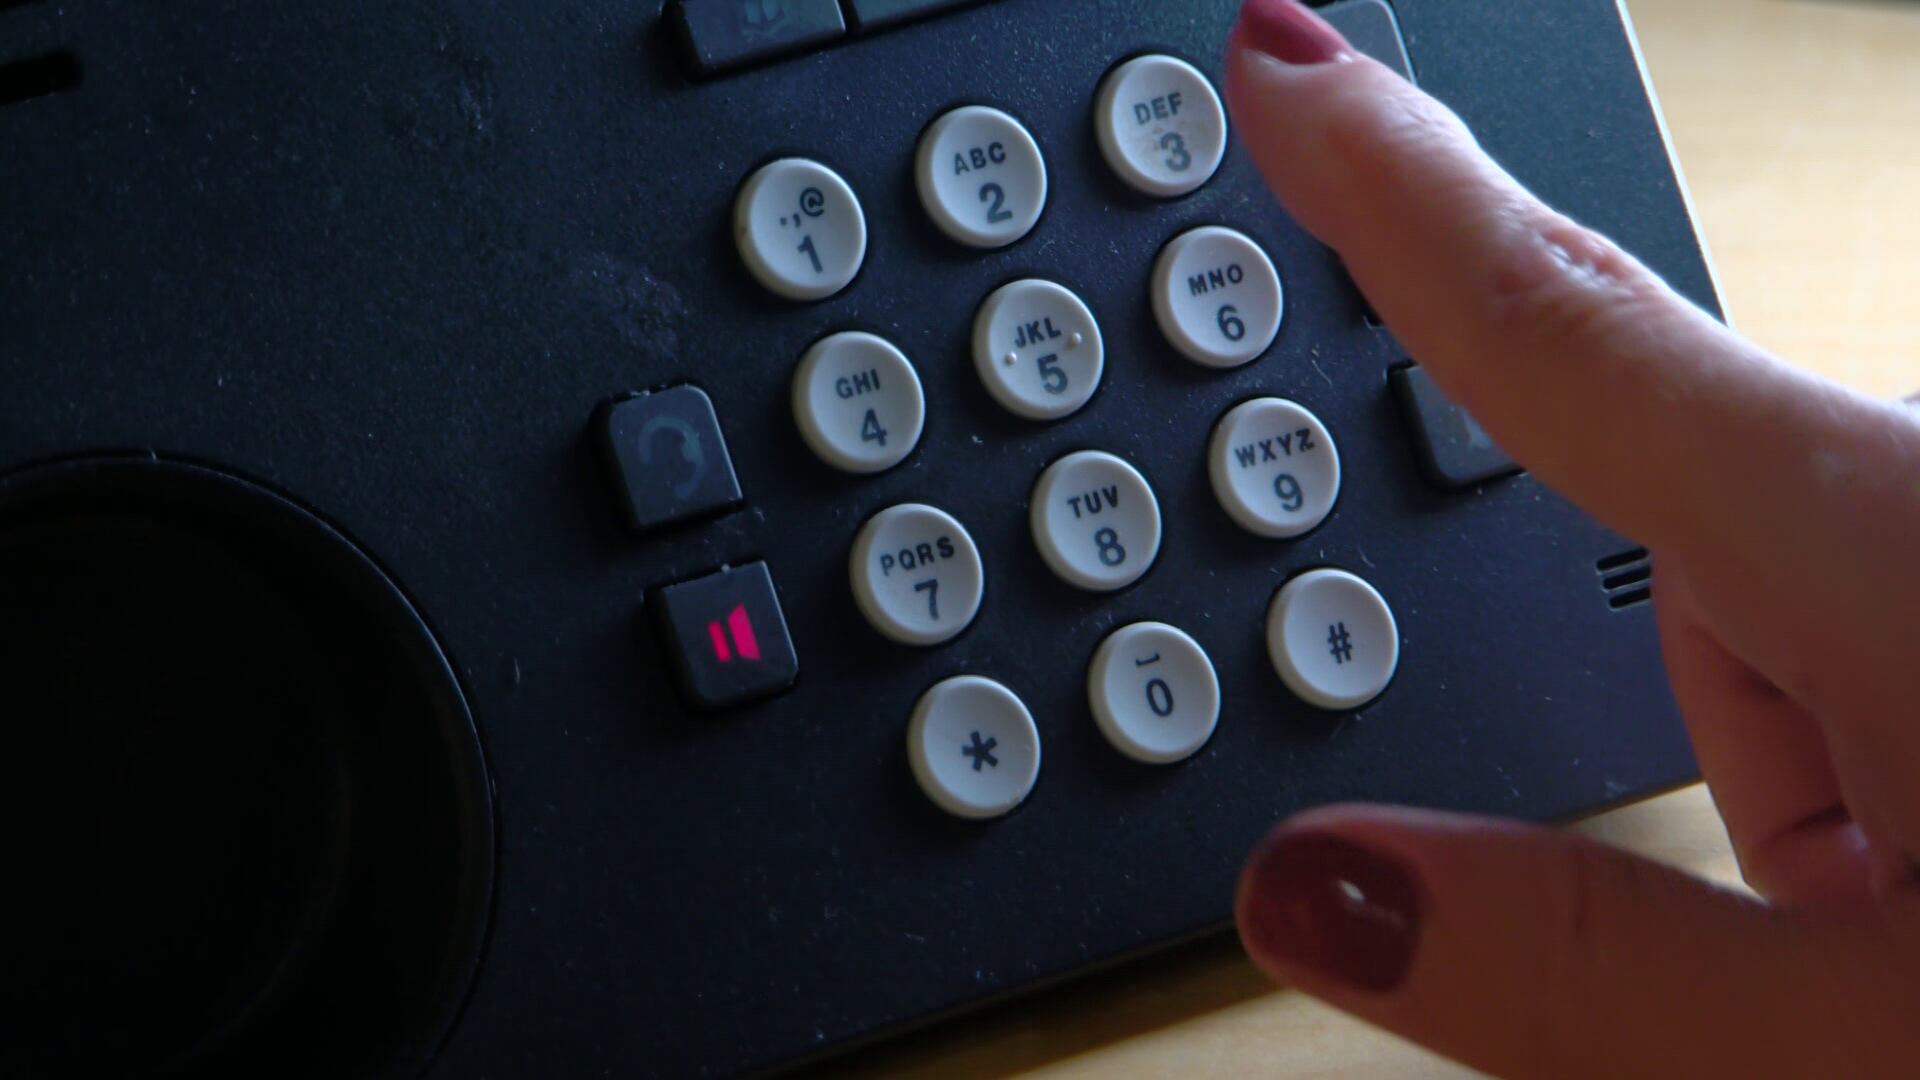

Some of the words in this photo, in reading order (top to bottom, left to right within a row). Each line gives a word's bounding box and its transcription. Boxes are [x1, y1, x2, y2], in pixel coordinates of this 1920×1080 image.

[1134, 92, 1182, 125] DEF
[955, 142, 1006, 175] ABC
[1160, 132, 1192, 172] 3
[979, 183, 1013, 224] 2
[798, 235, 823, 274] 1
[1187, 264, 1244, 297] MNO
[1014, 317, 1062, 349] JKL
[1217, 303, 1246, 342] 6
[837, 369, 881, 398] GHI
[1038, 354, 1068, 395] 5
[861, 409, 888, 447] 4
[1235, 428, 1316, 468] WXYZ
[1066, 485, 1119, 519] TUV
[1273, 473, 1304, 512] 9
[880, 536, 954, 577] PQRS
[1095, 527, 1126, 567] 8
[914, 579, 939, 621] 7
[1328, 622, 1353, 665] #
[1145, 678, 1174, 718] 0
